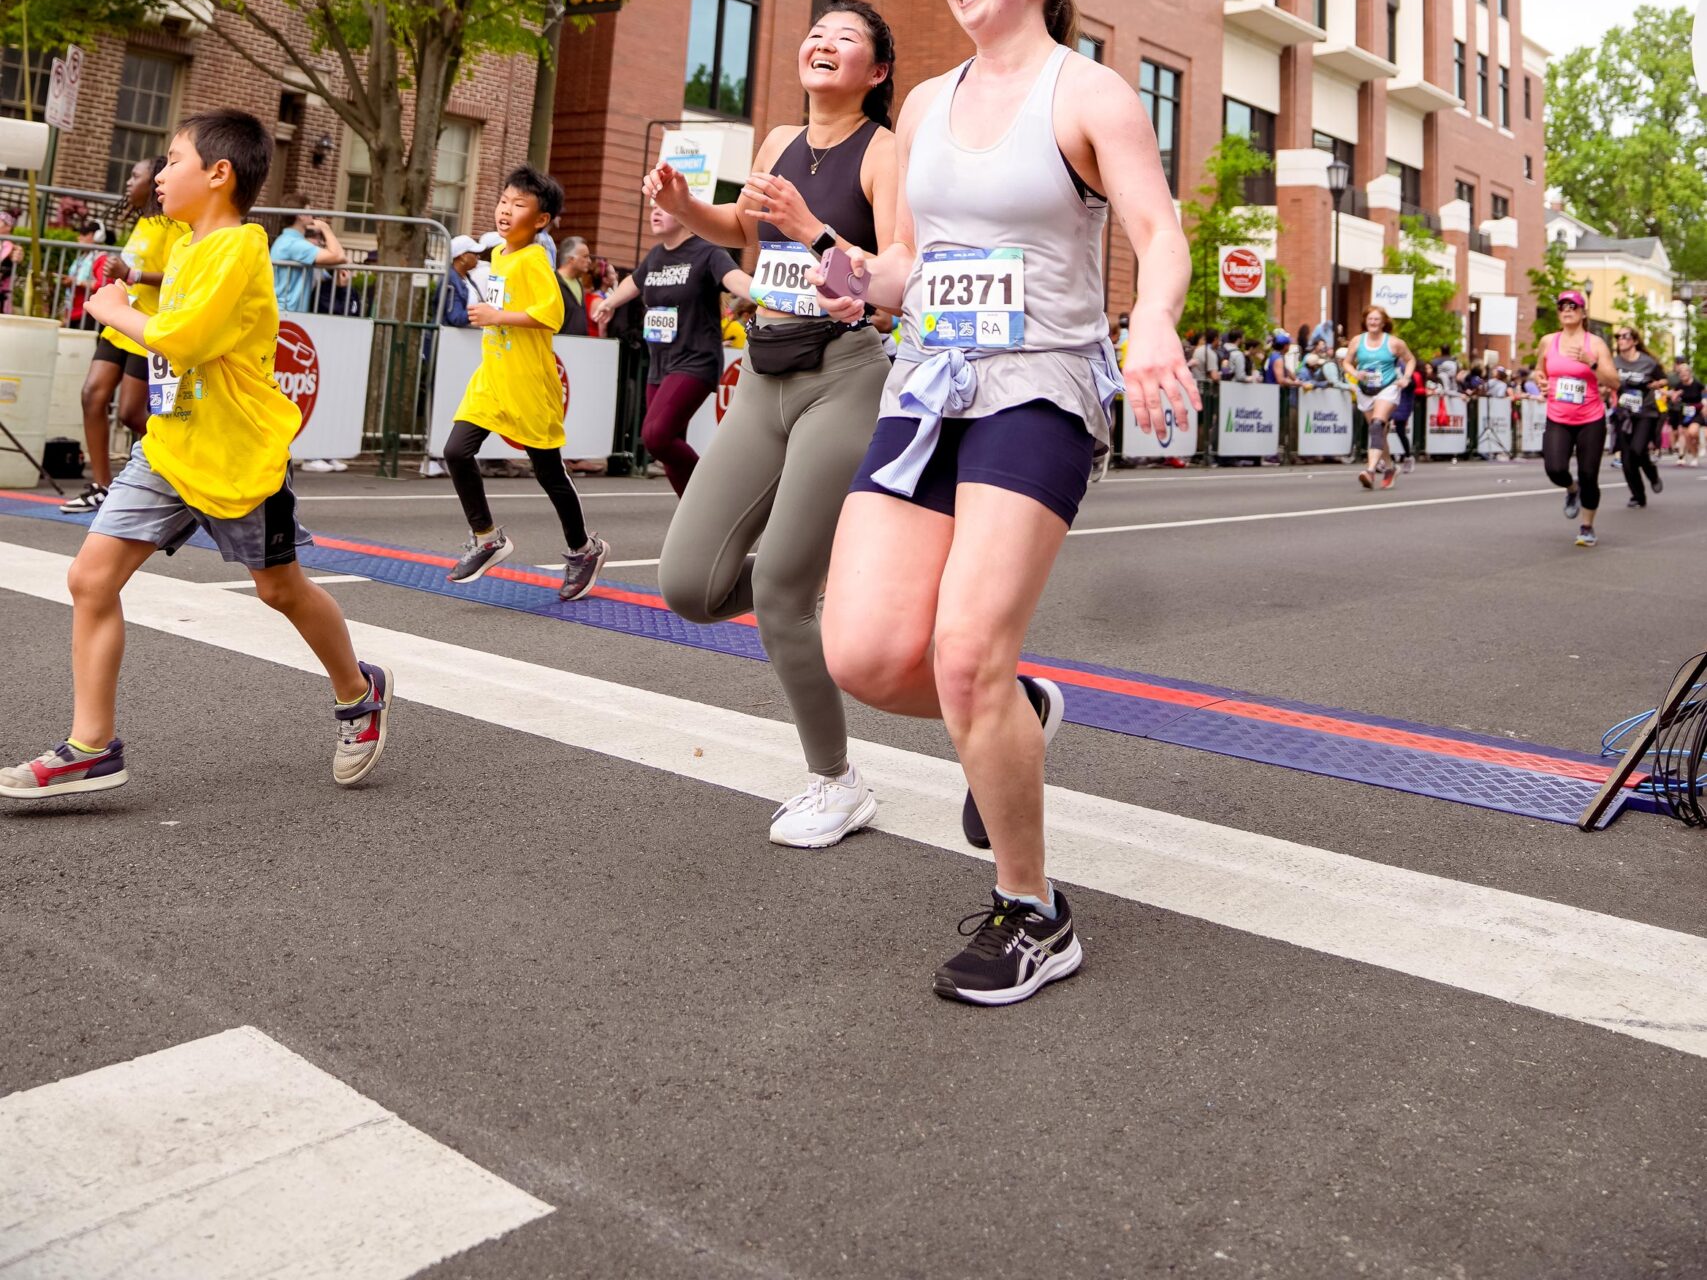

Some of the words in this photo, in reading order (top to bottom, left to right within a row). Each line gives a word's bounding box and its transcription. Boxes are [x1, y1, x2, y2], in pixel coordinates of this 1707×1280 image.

[644, 274, 689, 287] OVEMENT
[927, 273, 1012, 306] 12371
[647, 315, 675, 329] 16608
[981, 320, 1001, 335] RA
[274, 368, 317, 402] rop's
[1235, 407, 1263, 420] Atlantic
[1313, 410, 1338, 422] Atlantic
[1235, 421, 1254, 433] Union
[1256, 421, 1273, 434] Bank
[1313, 423, 1331, 434] Union
[1333, 423, 1348, 434] Bank
